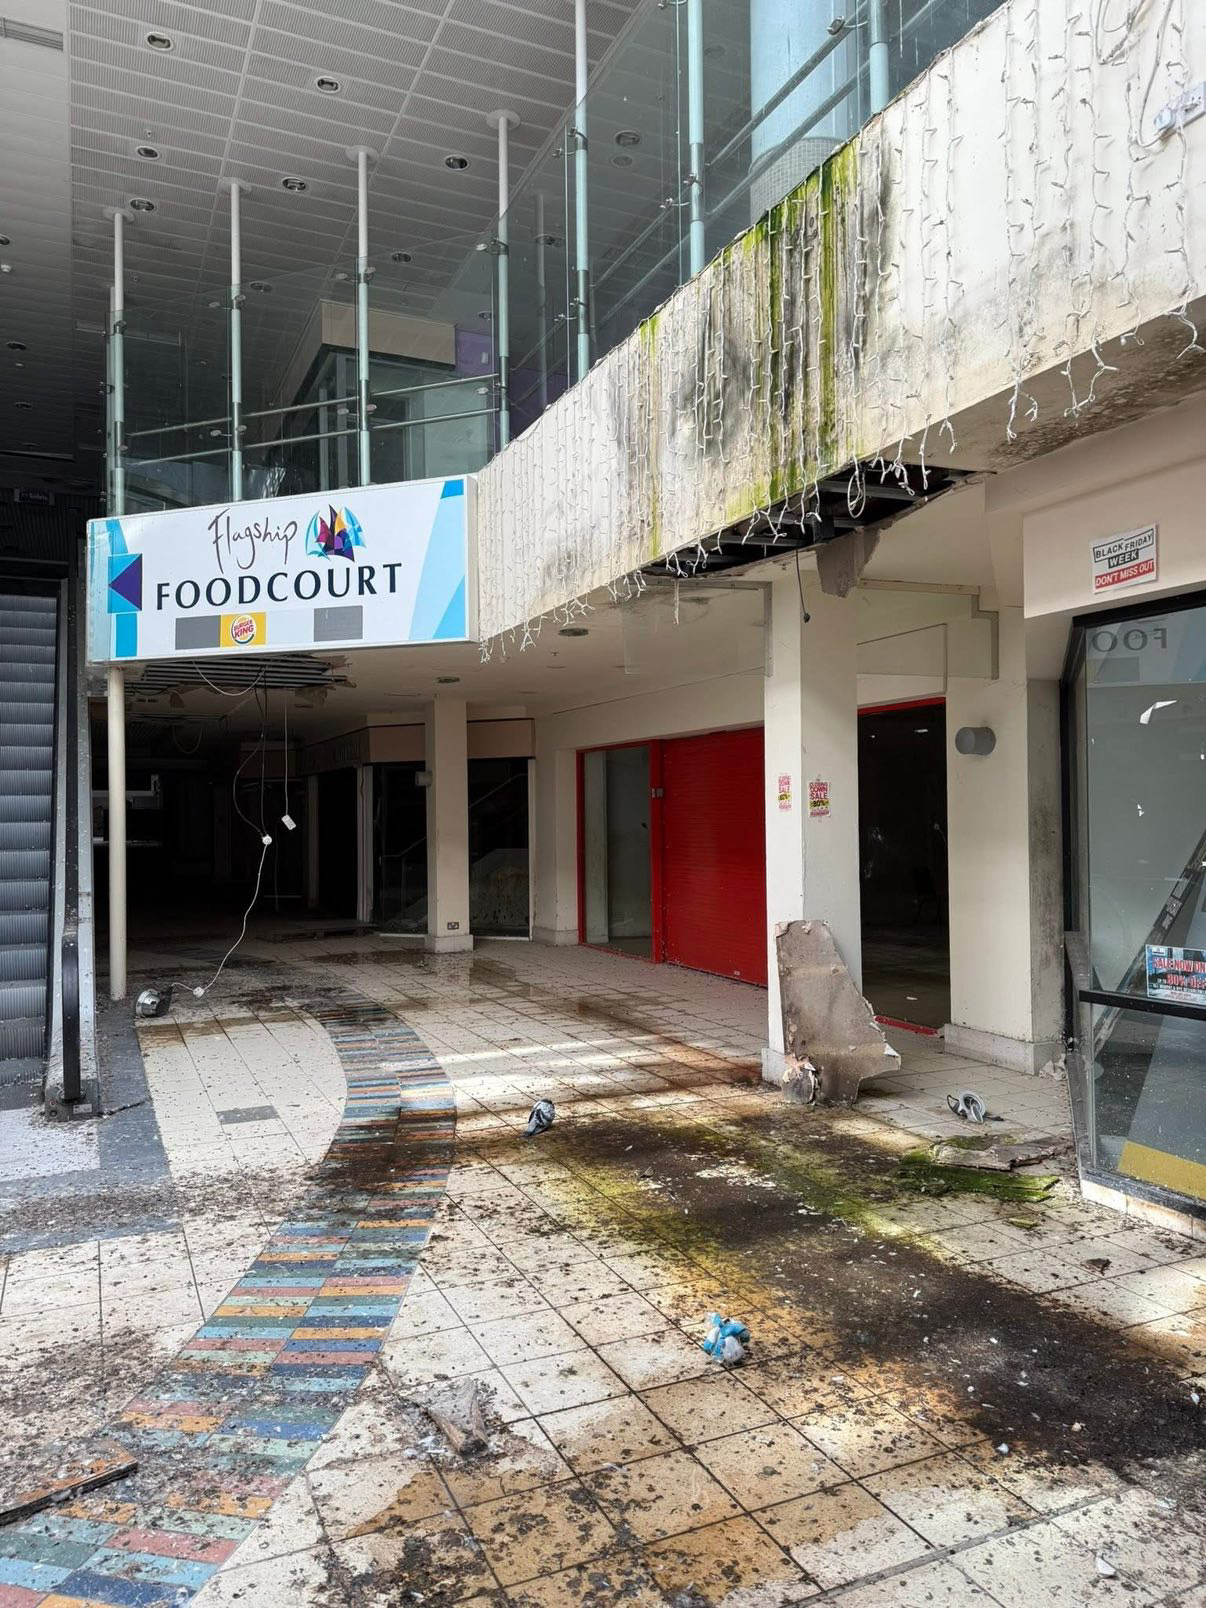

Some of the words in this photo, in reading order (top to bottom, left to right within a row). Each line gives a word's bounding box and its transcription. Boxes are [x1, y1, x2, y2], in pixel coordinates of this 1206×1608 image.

[208, 508, 298, 573] Flagship
[1095, 542, 1124, 559] BLACK
[1125, 534, 1153, 551] FRIDAY
[1109, 551, 1138, 567] WEEK
[1095, 571, 1119, 587] DON'T
[1119, 566, 1138, 581] MISS
[1138, 561, 1154, 574] OUT
[156, 562, 402, 611] FOODCOURT
[234, 619, 253, 631] BURGER
[234, 624, 254, 638] KING
[809, 792, 828, 800] SALE
[1153, 957, 1172, 969] SALE
[1174, 959, 1193, 972] NOW
